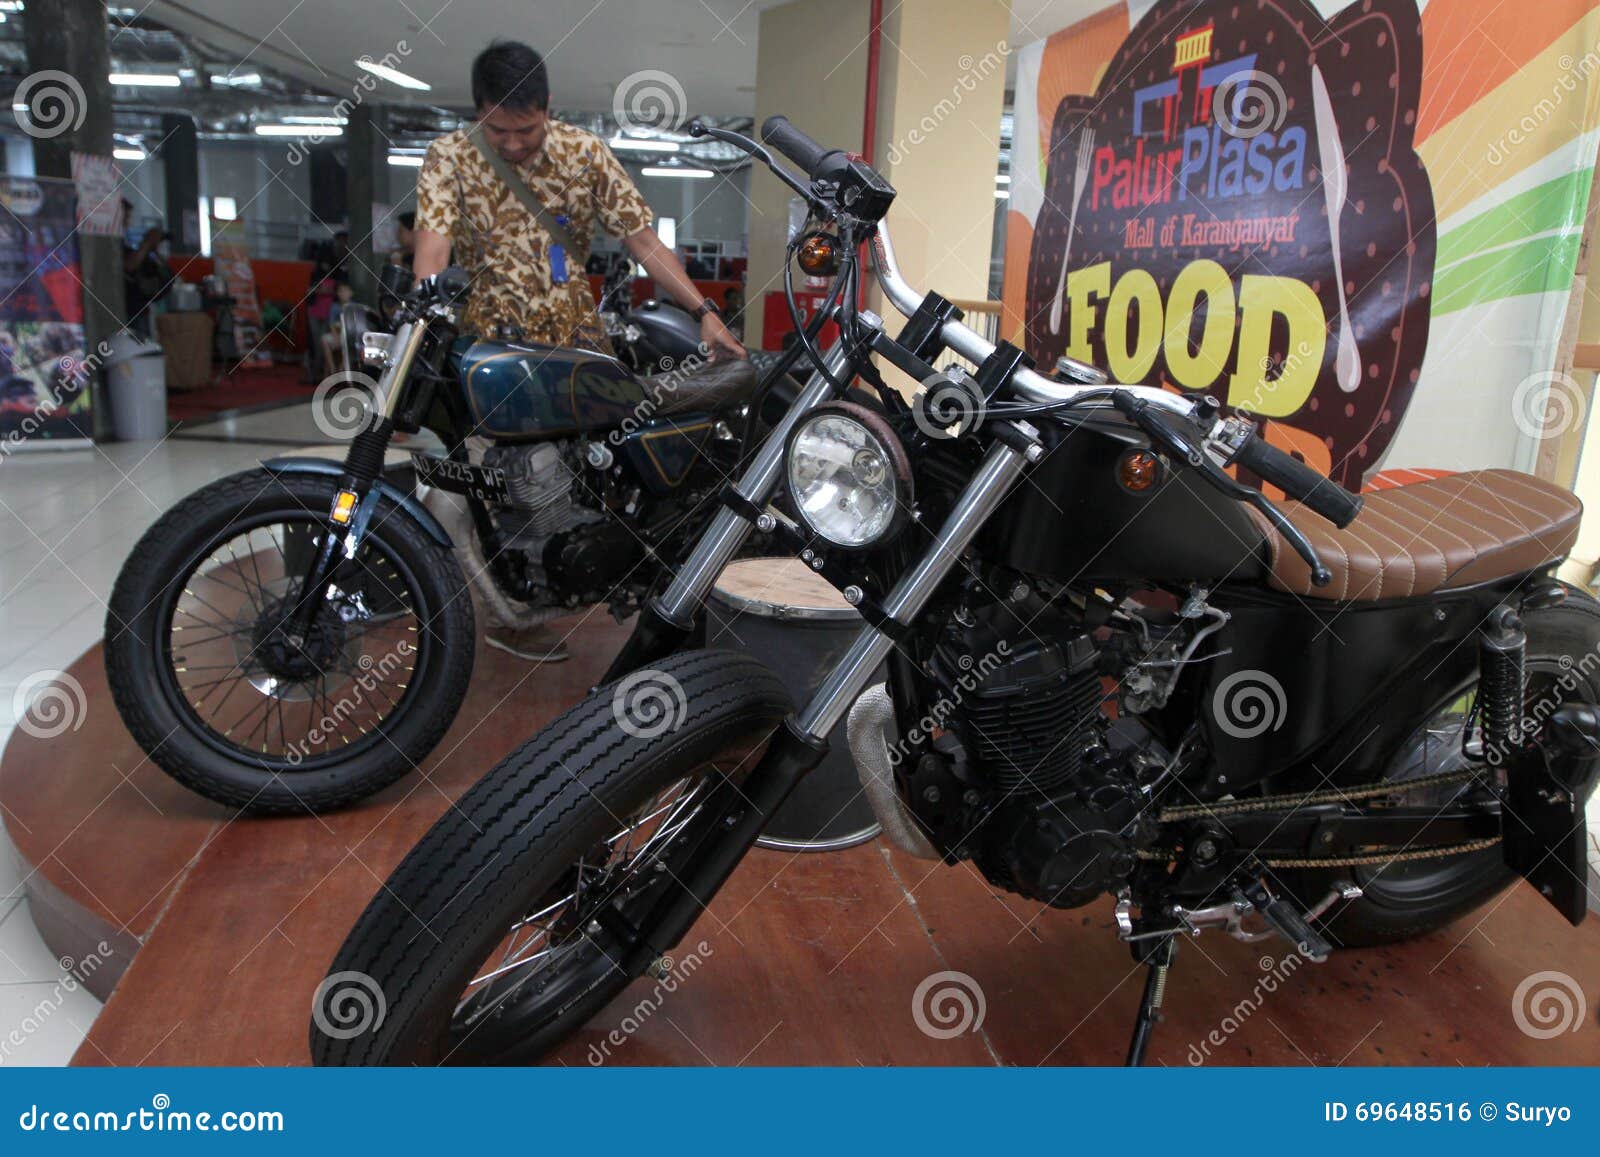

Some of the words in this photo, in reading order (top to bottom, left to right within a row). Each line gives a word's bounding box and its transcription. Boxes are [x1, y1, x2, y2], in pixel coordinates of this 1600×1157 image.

[1124, 217, 1156, 249] Mall
[1160, 214, 1179, 246] of
[1180, 213, 1300, 253] Karanganyar
[1066, 258, 1327, 418] FOOD
[435, 460, 475, 483] 3225
